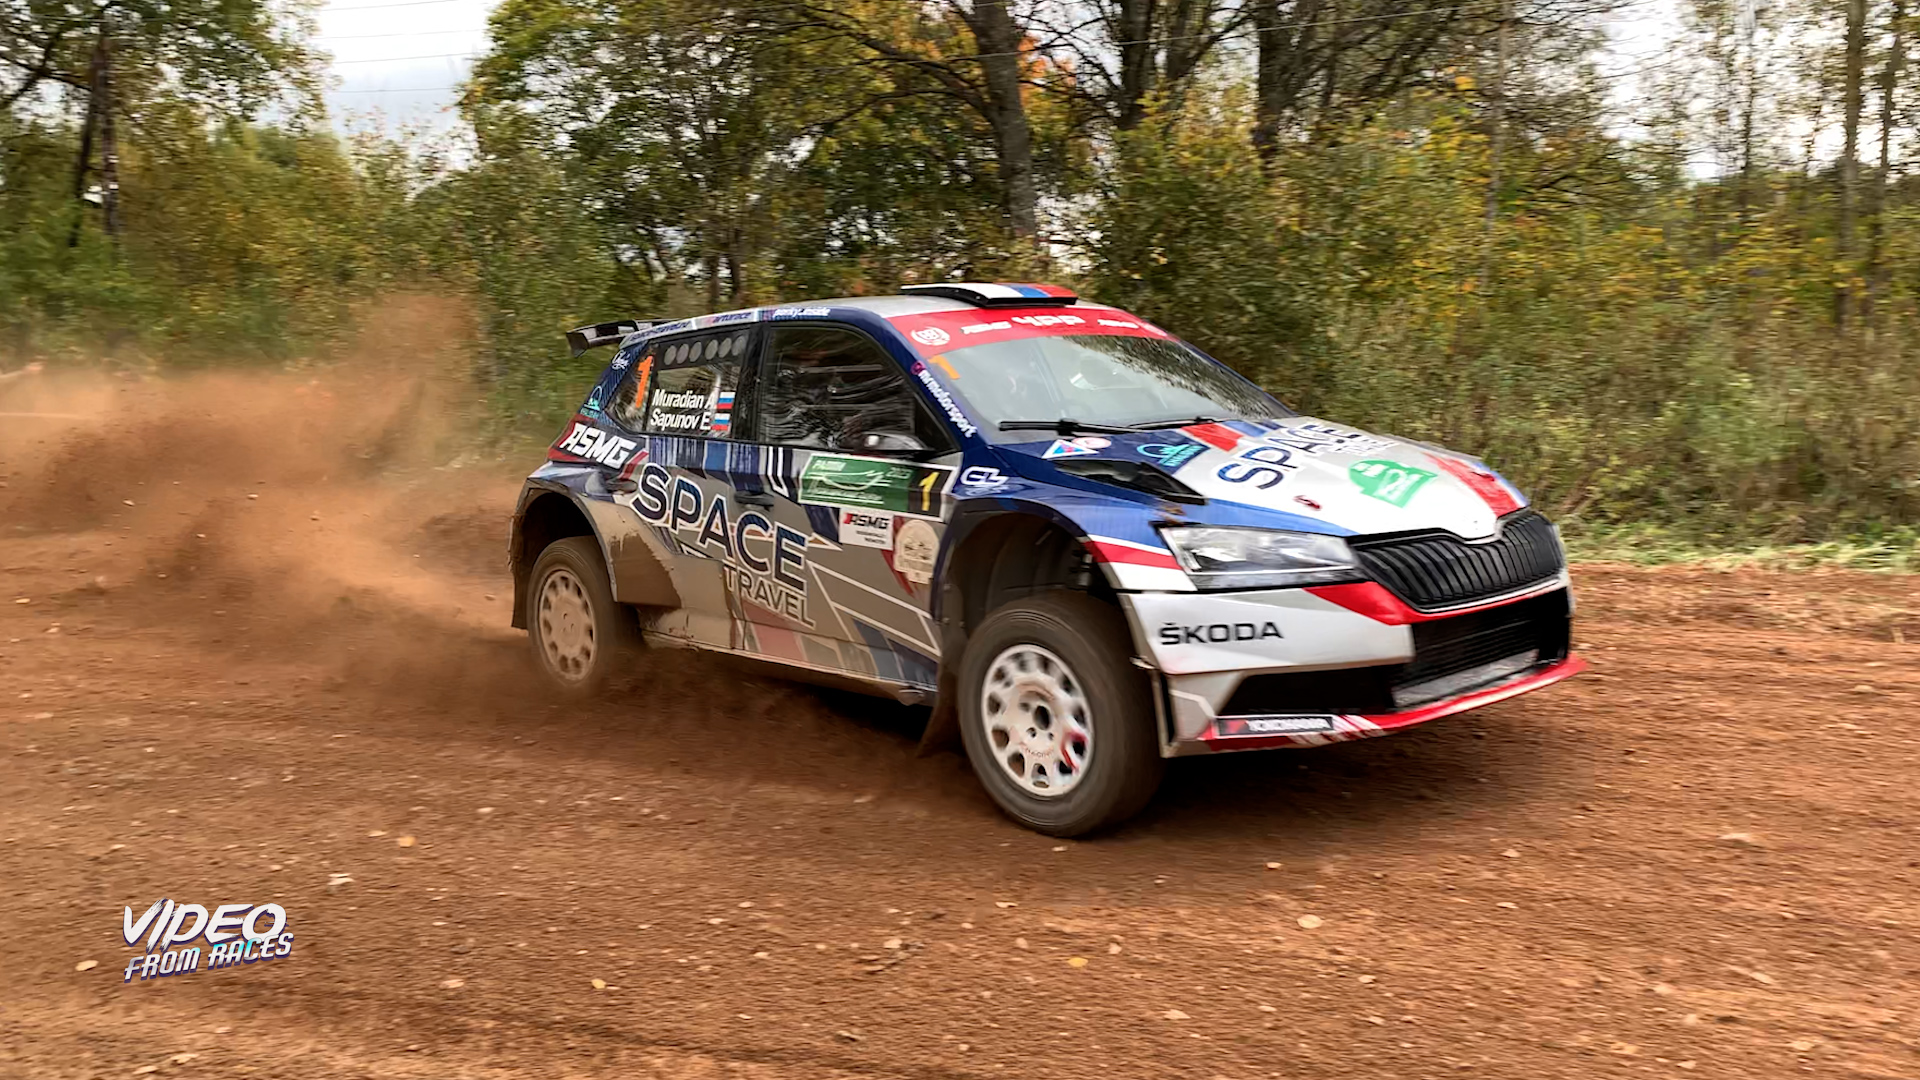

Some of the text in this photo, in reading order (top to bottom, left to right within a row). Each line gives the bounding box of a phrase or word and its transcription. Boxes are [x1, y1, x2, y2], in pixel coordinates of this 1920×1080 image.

[635, 355, 653, 409] 1
[652, 389, 704, 409] Muradian
[650, 408, 700, 431] Sapunov
[558, 422, 638, 470] ASMG
[919, 471, 940, 511] 1
[630, 462, 809, 596] SPACE
[843, 512, 890, 530] ASMG
[723, 564, 816, 630] TRAVEL
[1159, 621, 1284, 646] ŠKODA
